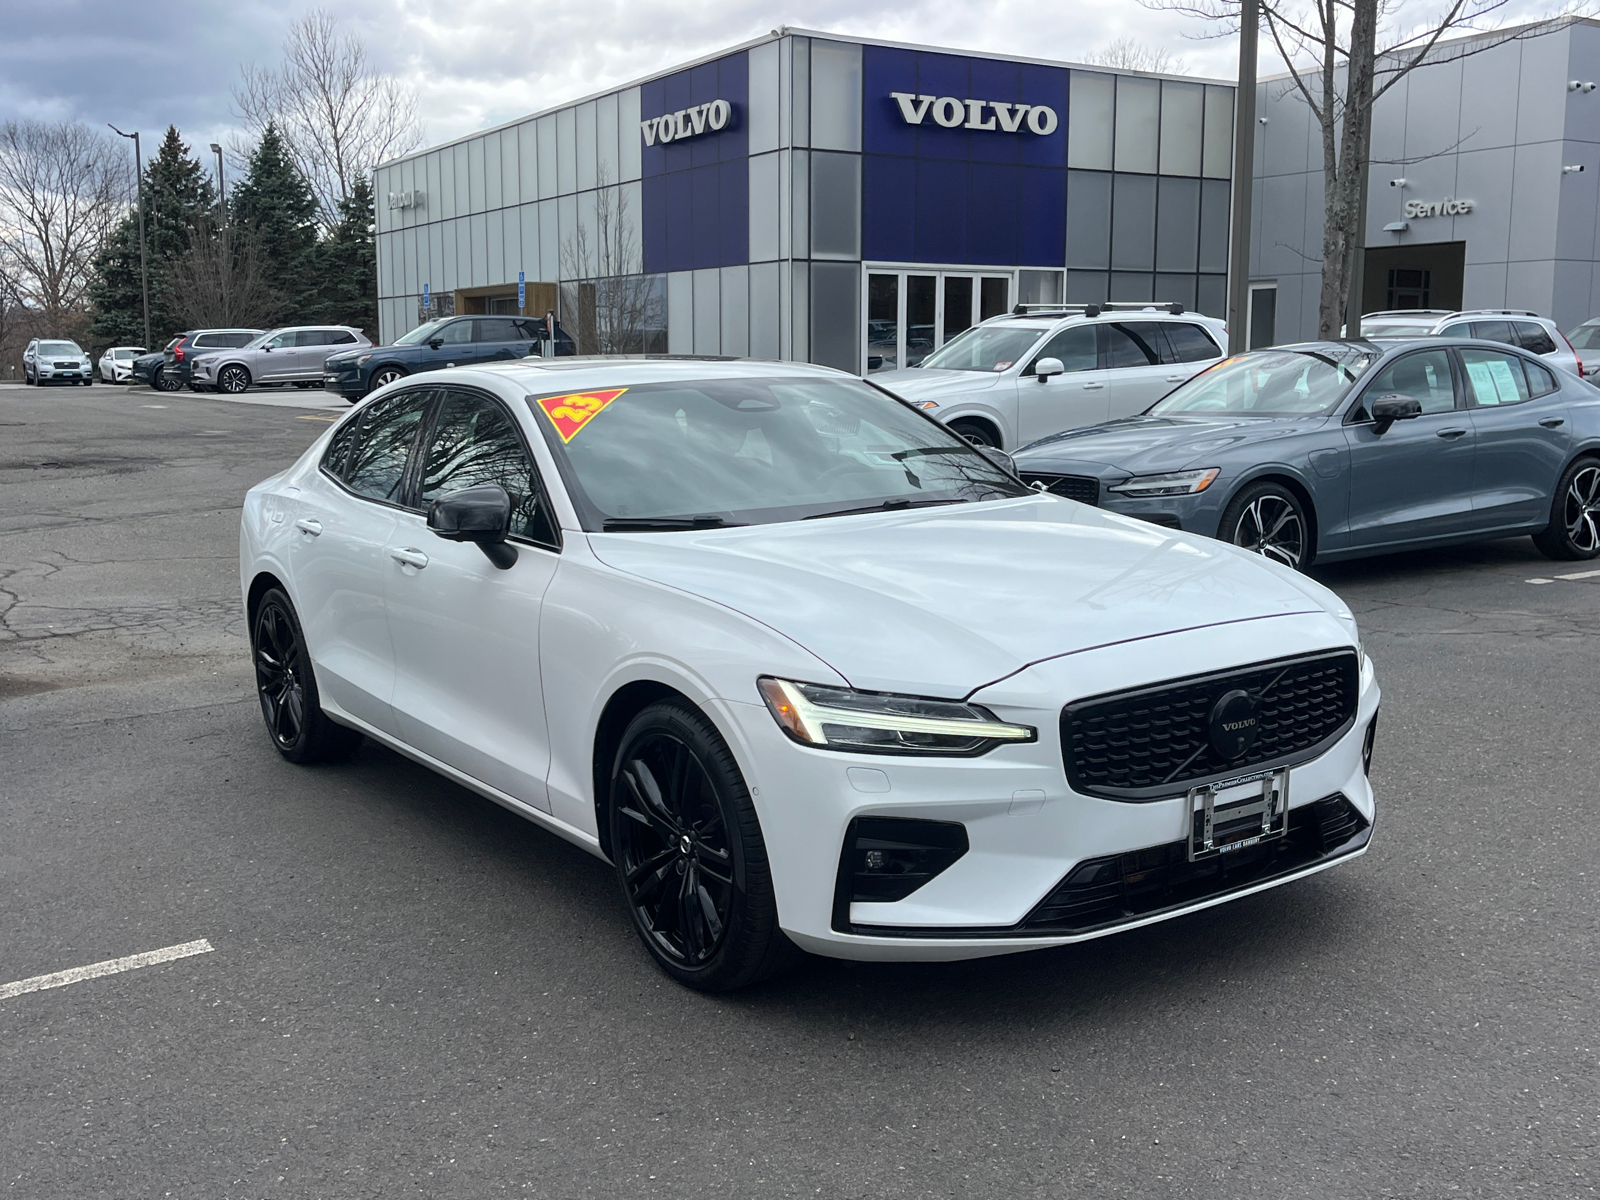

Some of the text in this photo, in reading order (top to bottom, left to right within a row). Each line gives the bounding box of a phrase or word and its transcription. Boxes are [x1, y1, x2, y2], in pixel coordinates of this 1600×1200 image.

[640, 99, 731, 147] VOLVO
[889, 92, 1058, 135] VOLVO
[1404, 197, 1472, 219] Service
[551, 395, 603, 423] 23
[1222, 718, 1256, 731] VOLVO
